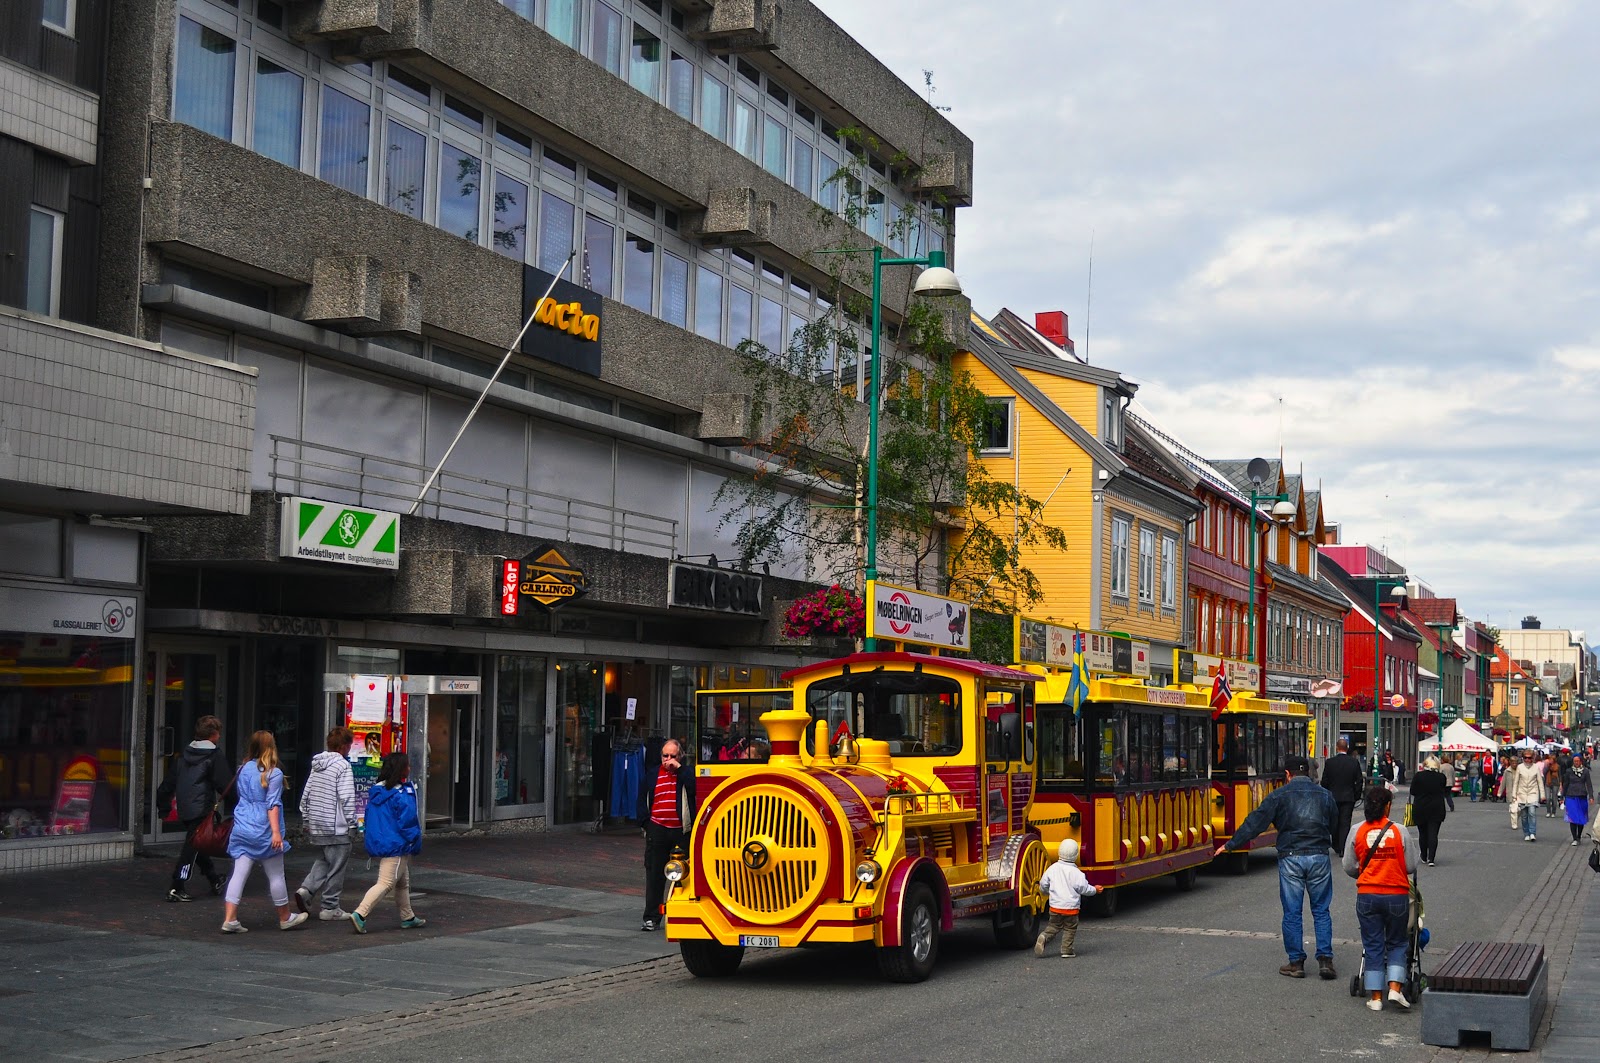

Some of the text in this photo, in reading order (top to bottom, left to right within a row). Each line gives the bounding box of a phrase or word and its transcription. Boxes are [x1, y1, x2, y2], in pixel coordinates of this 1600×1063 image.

[535, 297, 600, 342] acta
[297, 546, 346, 560] Arbeidstilsynet
[520, 583, 574, 595] CARLINGS
[674, 565, 762, 613] BIK BOK
[877, 600, 923, 624] MØBELRINGEN
[53, 619, 103, 631] GLASSGALLERIET
[453, 681, 471, 690] telenor
[1148, 690, 1186, 705] CITY SIGHTSEEING
[746, 937, 777, 946] FC 2081
